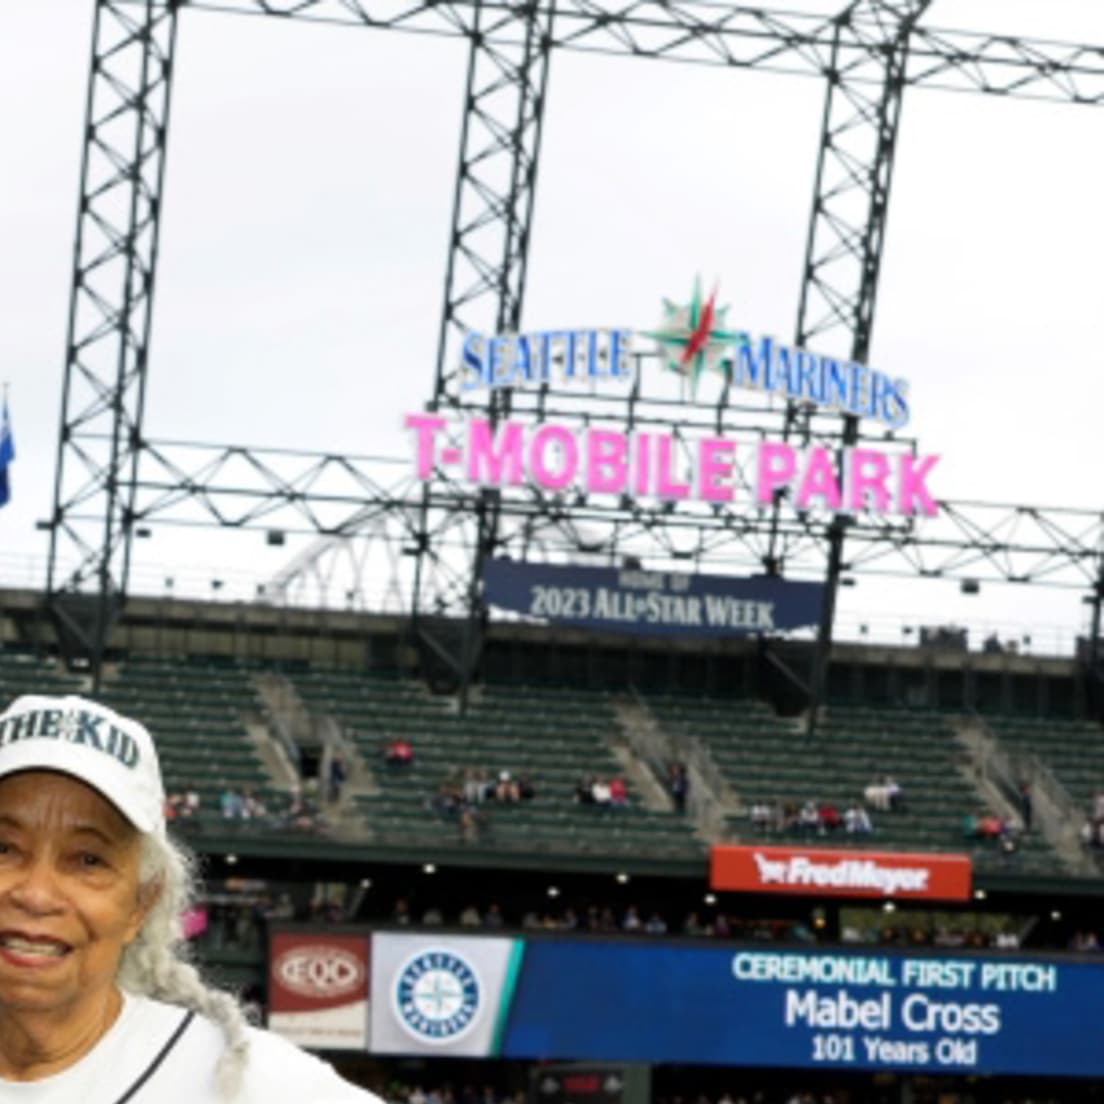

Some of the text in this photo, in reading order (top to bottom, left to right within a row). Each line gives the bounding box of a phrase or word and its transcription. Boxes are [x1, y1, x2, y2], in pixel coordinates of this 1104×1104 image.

[462, 328, 910, 428] SEATTLE MARINERS
[405, 414, 940, 517] T-MOBILE PARK
[531, 585, 590, 616] 2023
[704, 594, 775, 629] WEEK
[73, 709, 140, 769] KID
[732, 953, 1057, 992] CEREMONIAL FIRST PITCH
[785, 989, 1000, 1034] Mabel Cross
[812, 1035, 978, 1065] 101 Years Old
